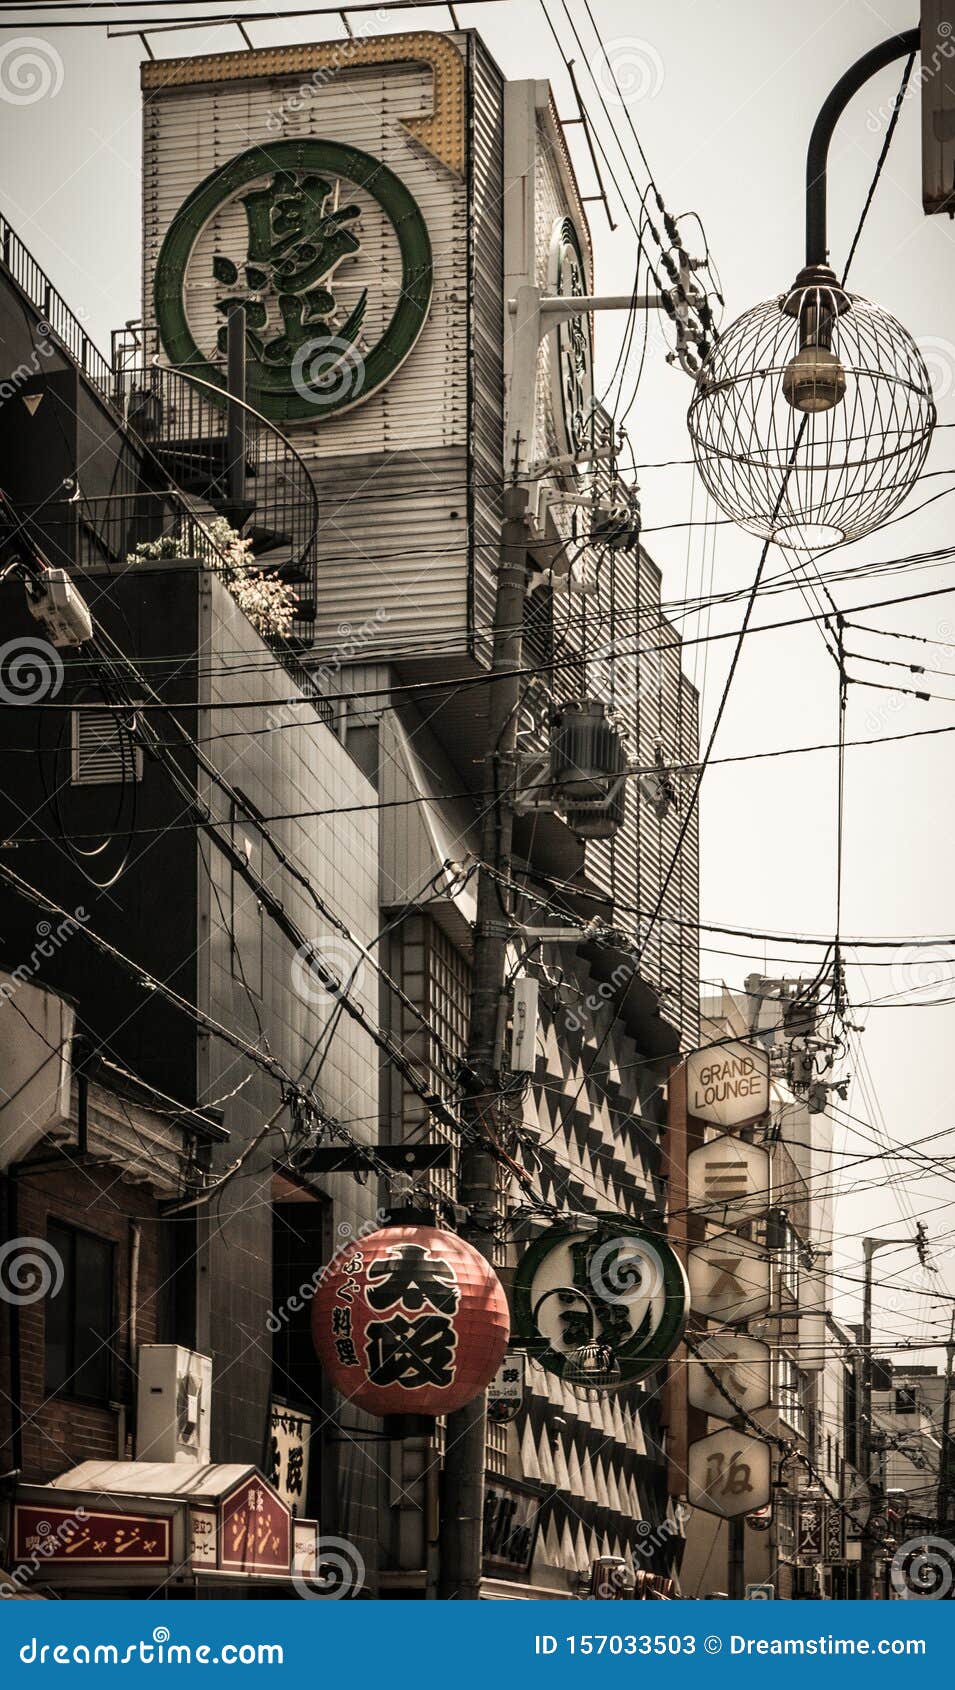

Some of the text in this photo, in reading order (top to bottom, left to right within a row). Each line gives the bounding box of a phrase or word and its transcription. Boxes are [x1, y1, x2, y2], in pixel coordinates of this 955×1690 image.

[701, 1056, 754, 1086] GRAND
[695, 1077, 761, 1109] LOUNGE
[331, 1251, 364, 1368] ふぐ料理
